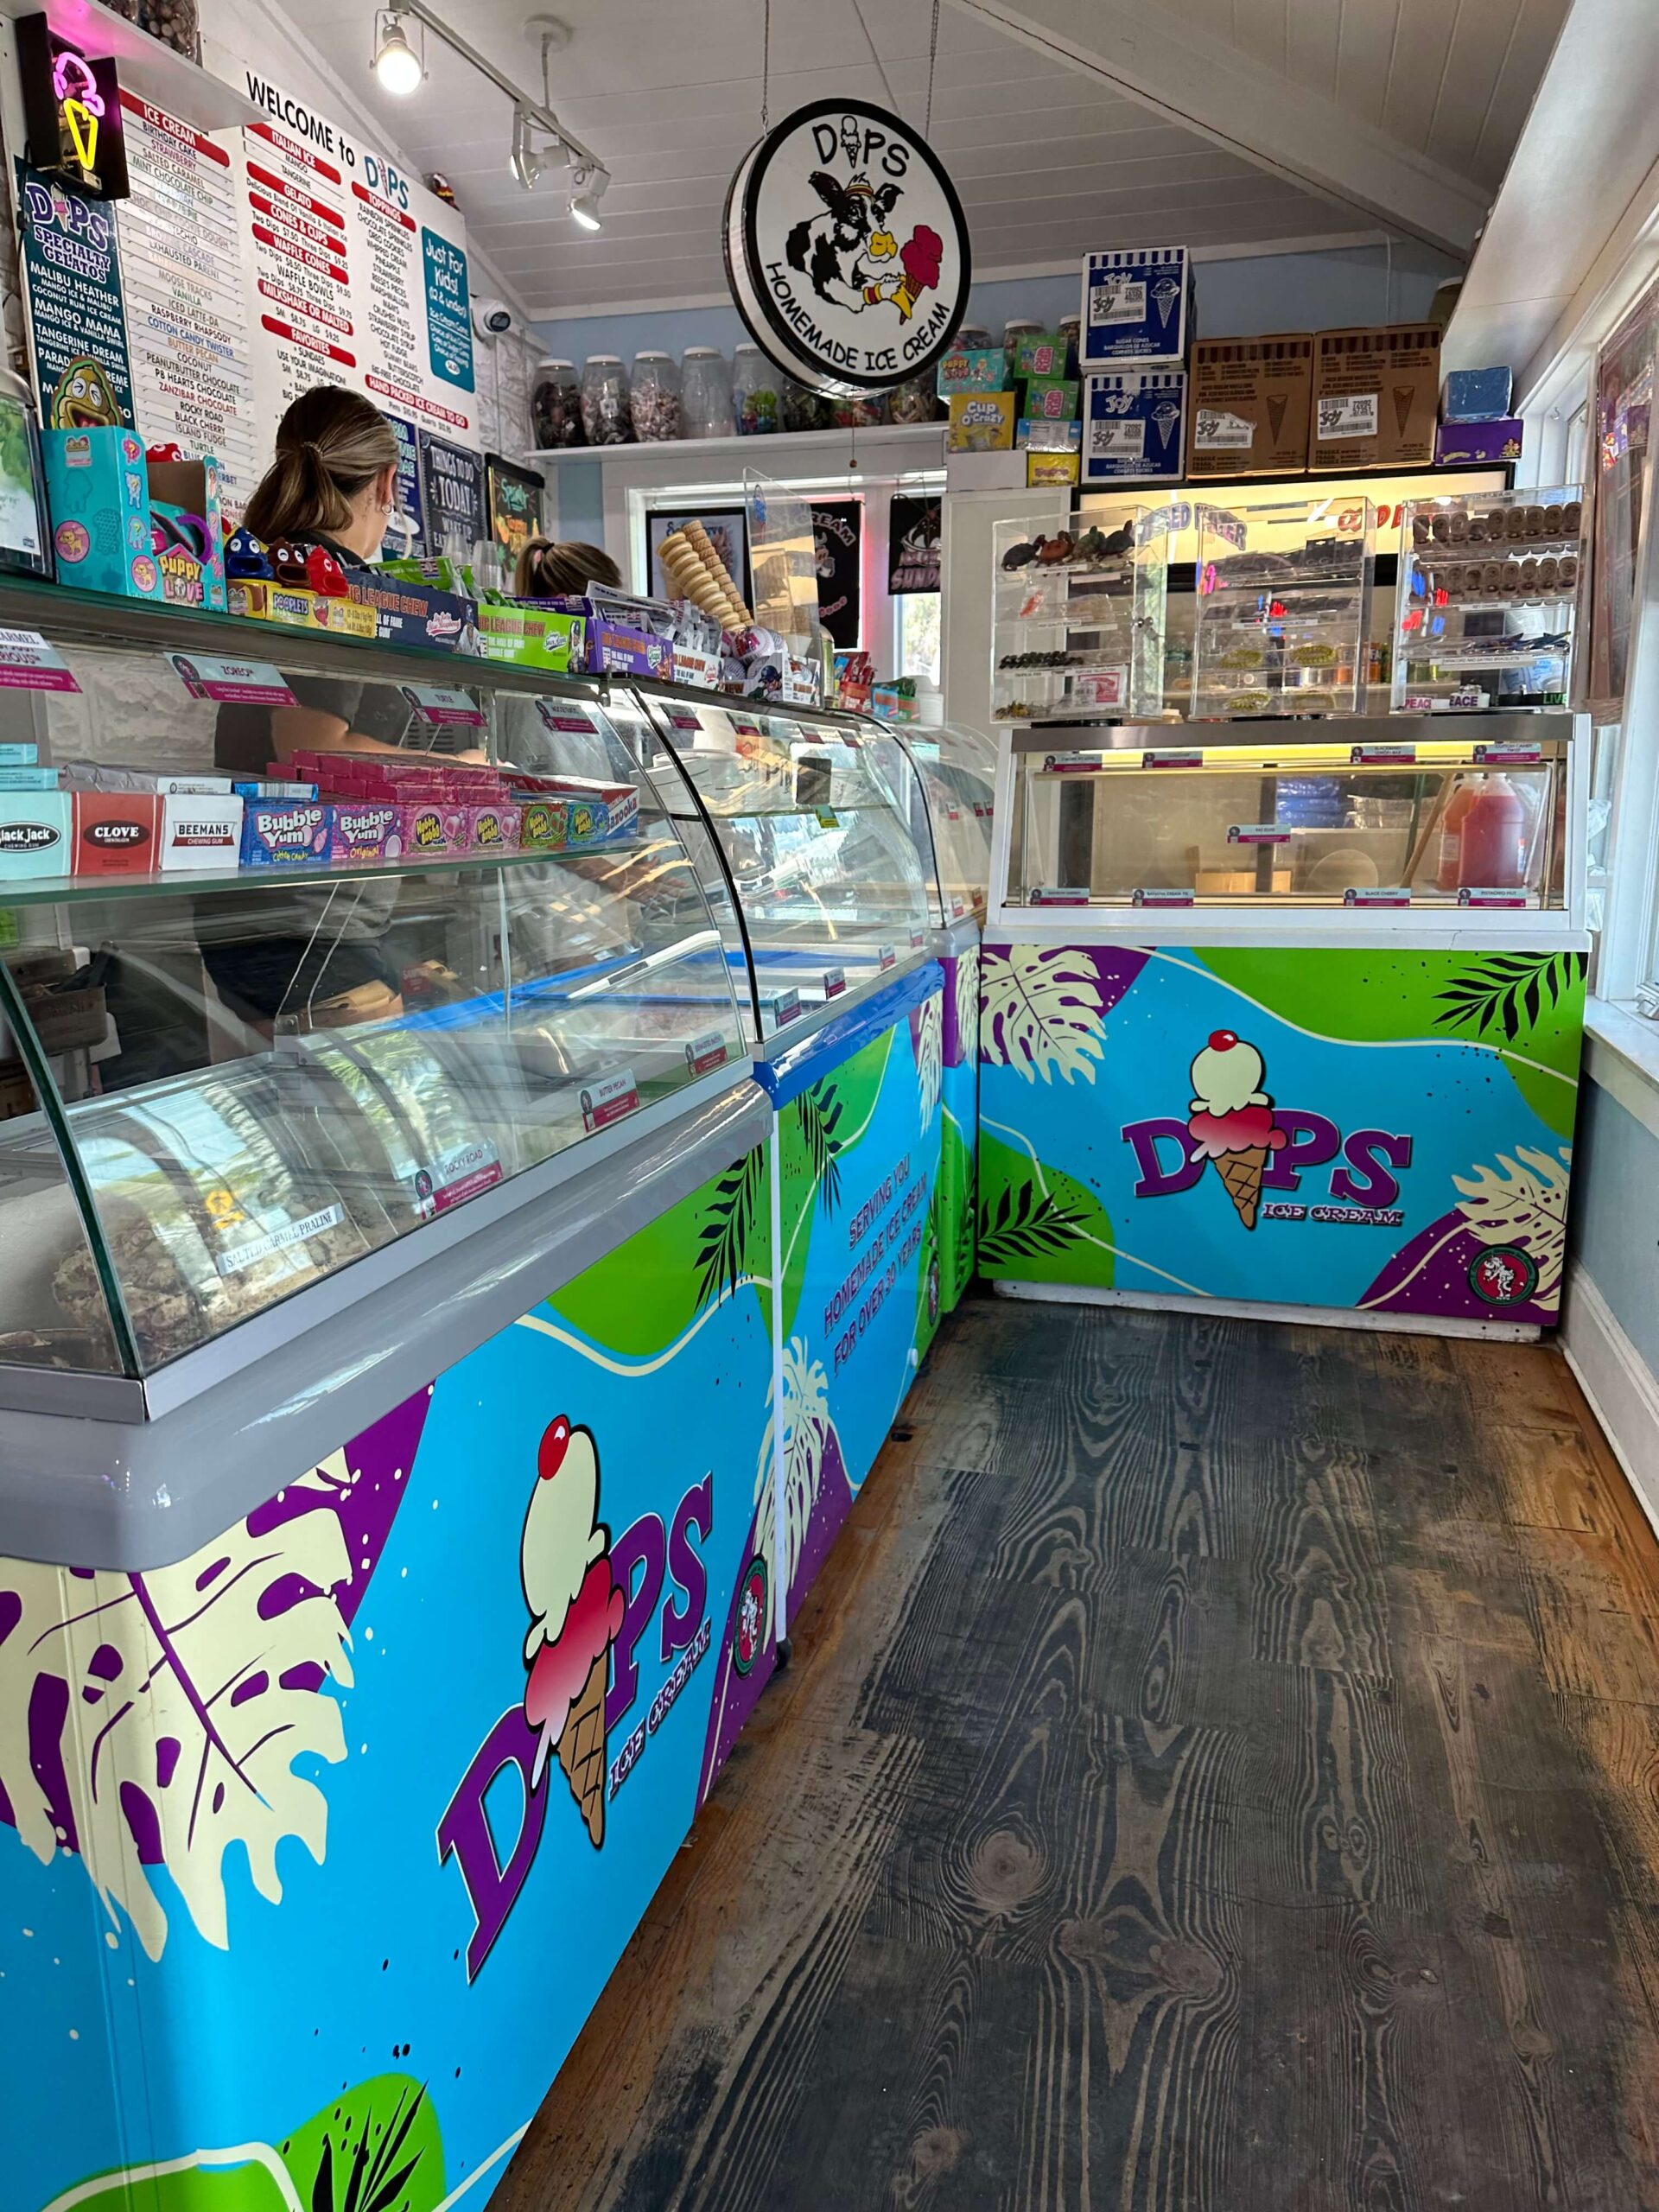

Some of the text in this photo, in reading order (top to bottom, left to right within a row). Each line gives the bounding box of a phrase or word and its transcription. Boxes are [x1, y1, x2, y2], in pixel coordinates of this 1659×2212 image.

[143, 105, 196, 146] ICE CREAM
[246, 71, 334, 155] WELCOME
[339, 136, 355, 167] to
[143, 121, 197, 159] BIRTHDAY CAKE
[151, 139, 196, 171] STRAWBERRY
[271, 130, 316, 168] ITALIAN ICE
[143, 148, 205, 189] SALTED CARAMEL
[285, 155, 308, 173] MANGO
[132, 156, 152, 173] MINT
[155, 168, 195, 200] CHOCOLATE
[196, 191, 213, 205] CHIP
[283, 184, 313, 209] GELATO
[252, 210, 279, 232] Two Dips
[270, 205, 298, 229] CONES
[308, 226, 329, 245] CUPS
[34, 224, 111, 271] SPECIALTY
[43, 244, 106, 283] GELATOS
[149, 239, 191, 266] EXHAUSTED
[255, 241, 282, 263] Two Dips
[273, 234, 332, 275] WAFFLE CONES
[426, 238, 464, 276] Just For
[30, 261, 119, 307] MALIBU HEATHER
[41, 276, 66, 294] MANGO
[158, 270, 185, 289] MOOSE
[187, 283, 213, 302] TRACKS
[172, 286, 202, 307] VANILLA
[276, 264, 334, 301] WAFFLE BOWLS
[32, 283, 121, 325] COCONUT RUM ICE CREAM
[35, 297, 121, 340] MANGO MAMA
[168, 299, 219, 327] ICED LATTE-DA
[263, 281, 350, 333] MILKSHAKE OR MALTED
[766, 261, 950, 372] HOMEMADE ICE CREAM
[35, 308, 60, 324] MANGO
[61, 319, 72, 328] ICE
[79, 326, 105, 340] VANILLA
[147, 316, 234, 358] COTTON CANDY TWISTER
[151, 304, 232, 345] RASPBERRY RHAPSODY
[35, 322, 124, 365] TANGERINE DREAM
[168, 336, 219, 364] BUTTER PECAN
[290, 327, 331, 355] FAVORITES
[147, 352, 240, 394] PEANUTBUTTER CHOCOLATE
[177, 352, 213, 372] COCONUT
[155, 368, 237, 405] PB HEARTS CHOCOLATE
[159, 381, 238, 416] ZANZIBAR CHOCOLATE
[175, 411, 226, 435] BLACK CHERRY
[180, 400, 224, 423] ROCKY ROAD
[967, 401, 996, 415] Cup
[175, 423, 227, 447] ISLAND FUDGE
[189, 439, 214, 454] TURTLE
[439, 476, 472, 516] TODAY
[159, 554, 202, 582] PUPPY
[891, 566, 941, 591] SUND
[362, 587, 400, 612] LEAGUE
[400, 595, 429, 618] CHEW
[0, 631, 40, 645] ARMEL
[94, 825, 139, 838] CLOVE
[178, 823, 229, 836] BEEMANS
[258, 807, 323, 833] Bubble
[340, 808, 394, 832] Bubble
[607, 796, 638, 836] azooka
[24, 828, 50, 843] Jack
[187, 837, 210, 846] CHEWING
[265, 830, 304, 849] Yum
[346, 828, 379, 846] Yum
[849, 1153, 911, 1251] SERVING YOU
[1262, 1202, 1404, 1227] ICE CREAM
[299, 1211, 334, 1235] PRALINE
[823, 1171, 928, 1338] HOMEMADE ICE CREAM
[833, 1318, 857, 1377] FOR
[858, 1276, 886, 1336] OVER
[897, 1219, 922, 1275] YEARS
[607, 1615, 712, 1803] ICE CREAM
